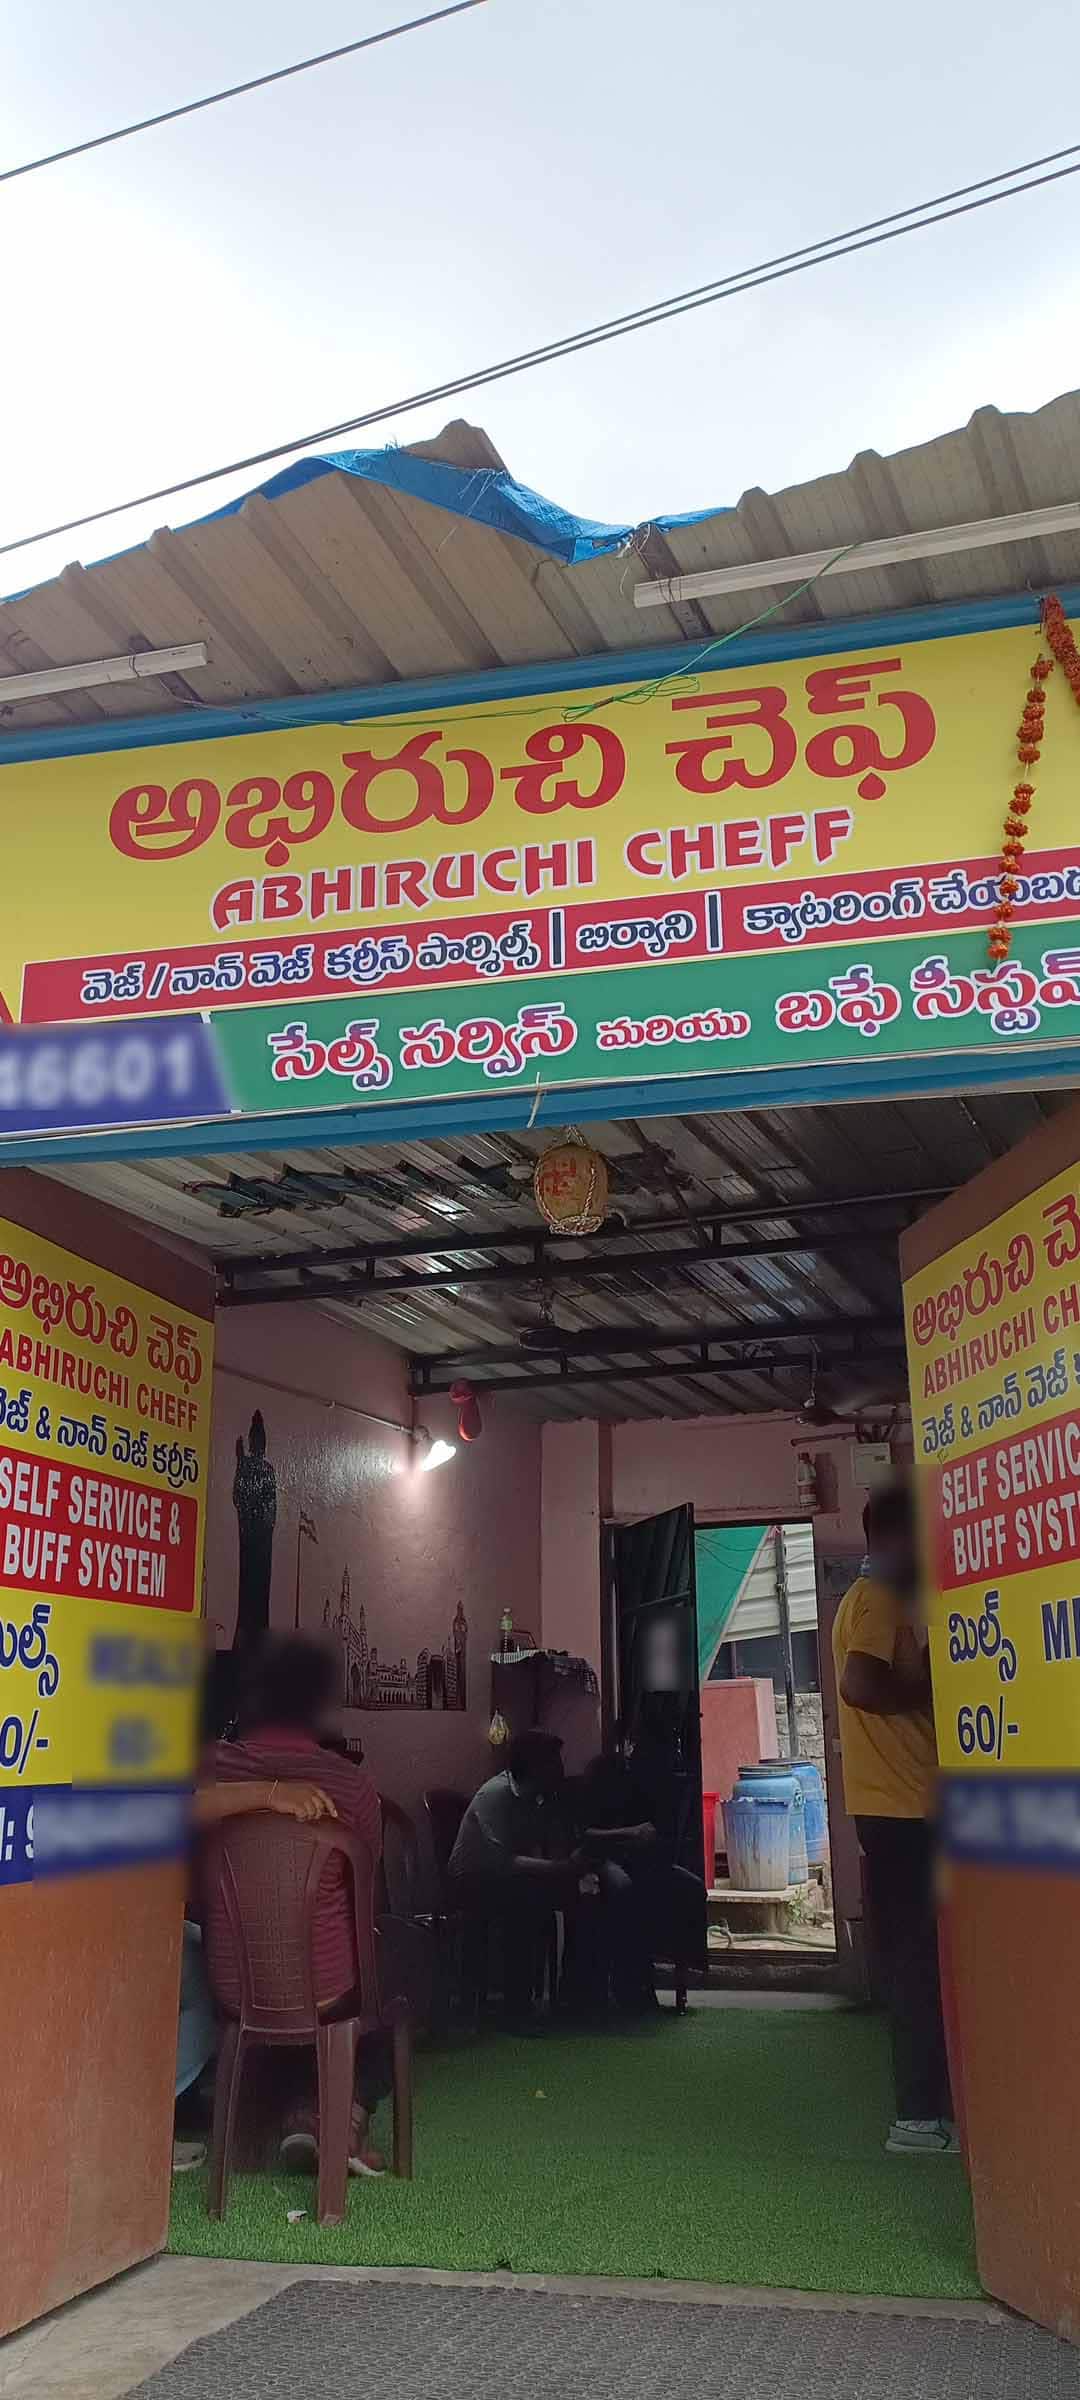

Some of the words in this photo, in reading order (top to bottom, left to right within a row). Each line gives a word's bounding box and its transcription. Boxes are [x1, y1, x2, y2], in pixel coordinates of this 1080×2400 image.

[108, 722, 627, 868] అభిరుచి
[664, 657, 937, 801] చెఫ్
[211, 837, 596, 932] ABHIRUCHI
[624, 807, 853, 880] CHEFF
[82, 963, 145, 1003] వెజ్
[171, 951, 244, 993] నాన్
[250, 944, 314, 986] వెజ్
[577, 909, 698, 957] బిర్యాని
[744, 877, 924, 940] క్యాటరింగ్
[399, 1002, 578, 1077] సర్విస్
[597, 1007, 751, 1051] మరియు
[775, 965, 902, 1037] బఫే
[0, 1253, 139, 1359] అభిరుచి
[146, 1314, 203, 1396] చెఫ్
[911, 1233, 1036, 1347] అభిరుచి
[0, 1328, 131, 1410] ABHIRUCHI
[136, 1382, 199, 1434] CHEFF
[921, 1402, 957, 1455] వెజ్
[960, 1405, 975, 1438] &
[977, 1371, 1023, 1432] నాన్
[1024, 1346, 1070, 1410] వెజ్
[923, 1306, 1039, 1400] ABHIRUCHI
[35, 1405, 52, 1442] &
[56, 1413, 109, 1457] నాన్
[111, 1425, 150, 1470] వెజ్
[941, 1456, 989, 1520] SELF
[0, 1456, 62, 1519] SELF
[67, 1474, 163, 1543] SERVICE
[167, 1501, 182, 1546] &
[952, 1513, 1008, 1577] BUFF
[1014, 1484, 1080, 1560] SYST
[3, 1522, 73, 1584] BUFF
[77, 1537, 167, 1599] SYSTEM
[957, 1695, 1019, 1762] 60/-
